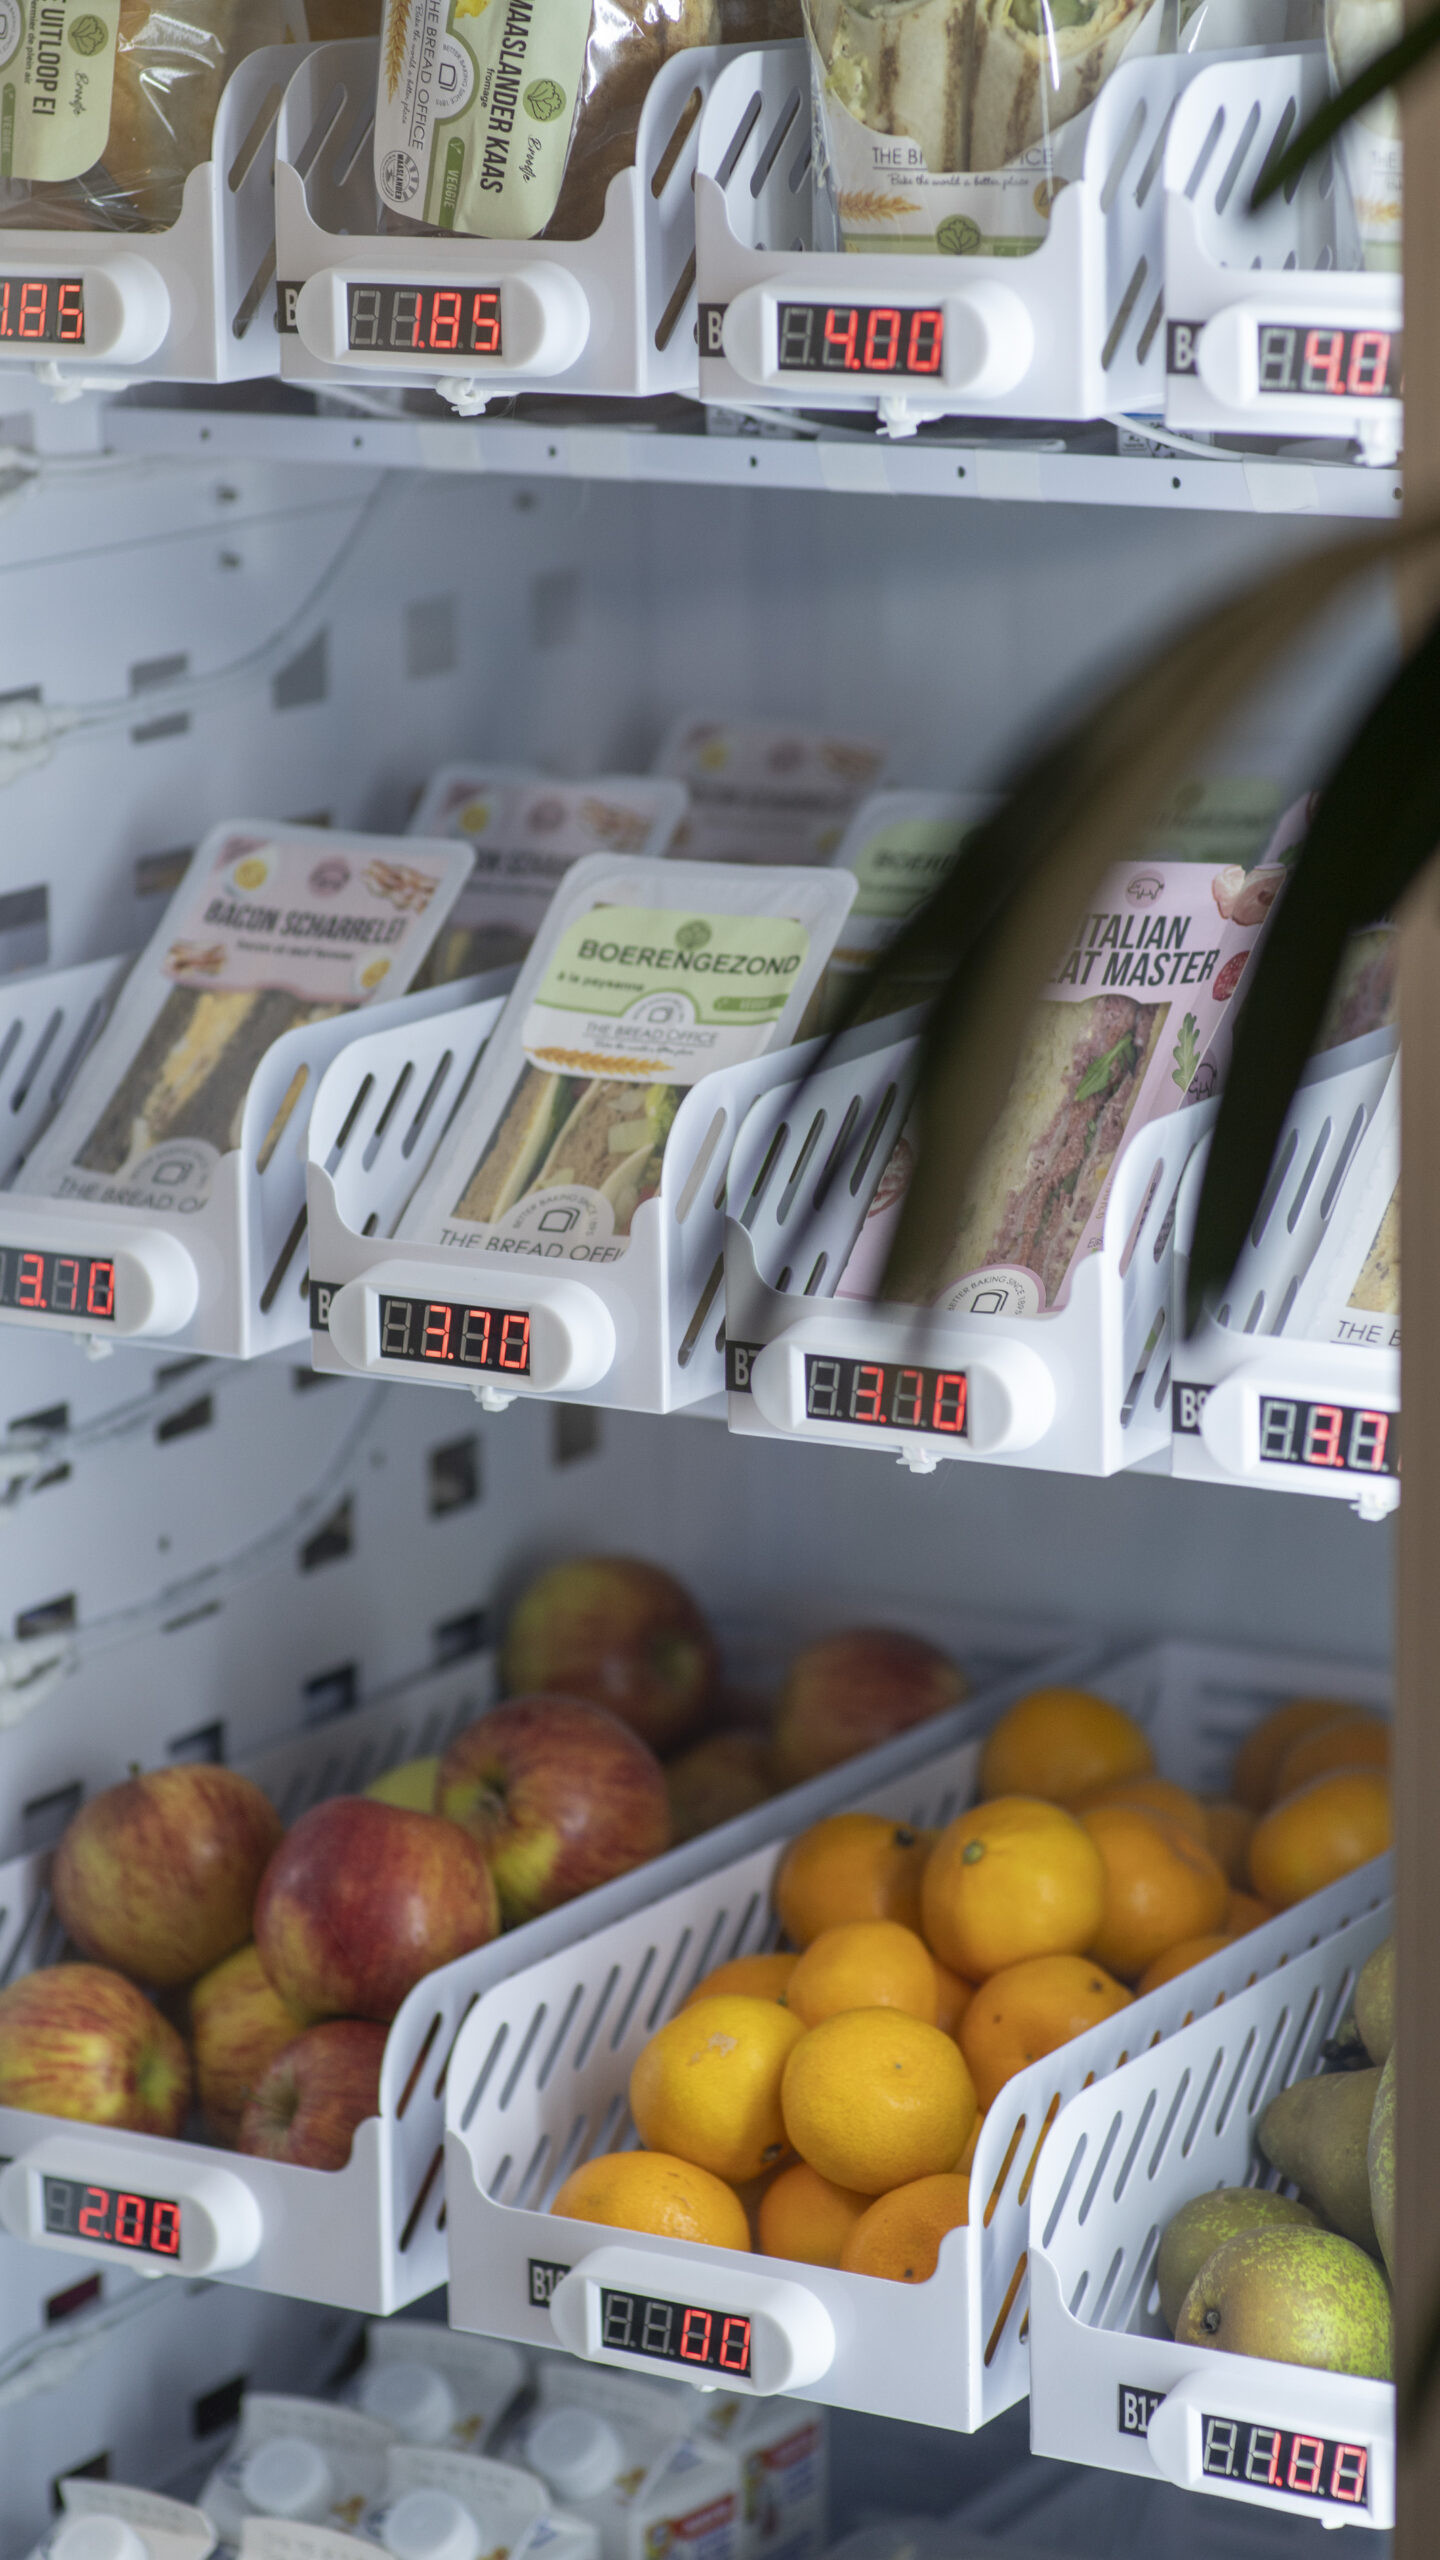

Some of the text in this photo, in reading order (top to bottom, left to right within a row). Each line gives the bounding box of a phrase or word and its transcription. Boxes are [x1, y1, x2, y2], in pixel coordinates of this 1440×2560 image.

[28, 0, 37, 31] ermier
[25, 46, 35, 71] plein
[28, 32, 36, 45] de
[32, 8, 65, 116] UITLOOP EI
[410, 0, 441, 151] HE BREAD OFFICE
[480, 67, 496, 109] fromage
[480, 135, 510, 194] KAAS
[872, 146, 902, 166] THE
[442, 169, 460, 210] VEGGIE
[285, 288, 300, 326] B
[411, 291, 500, 351] 1.85
[707, 310, 723, 350] B
[823, 308, 945, 372] 4.00
[1174, 325, 1193, 370] B
[1303, 329, 1392, 396] 4.0
[203, 897, 281, 935] BACON
[1074, 912, 1193, 950] ITALIAN
[577, 938, 803, 977] BOERENGEZOND
[1056, 949, 1221, 987] AT MASTER
[439, 1228, 623, 1263] THE BREAD OFFI
[19, 1252, 116, 1316] 3.70
[970, 1275, 1008, 1290] BAKING
[1006, 1277, 1025, 1296] SINCE
[317, 1287, 332, 1325] B
[424, 1304, 531, 1370] 3.70
[1337, 1319, 1385, 1344] THE
[855, 1365, 968, 1432] 3.70
[1308, 1404, 1390, 1472] 3.7
[77, 2186, 182, 2255] 2.00
[1267, 2430, 1368, 2503] 1.00
